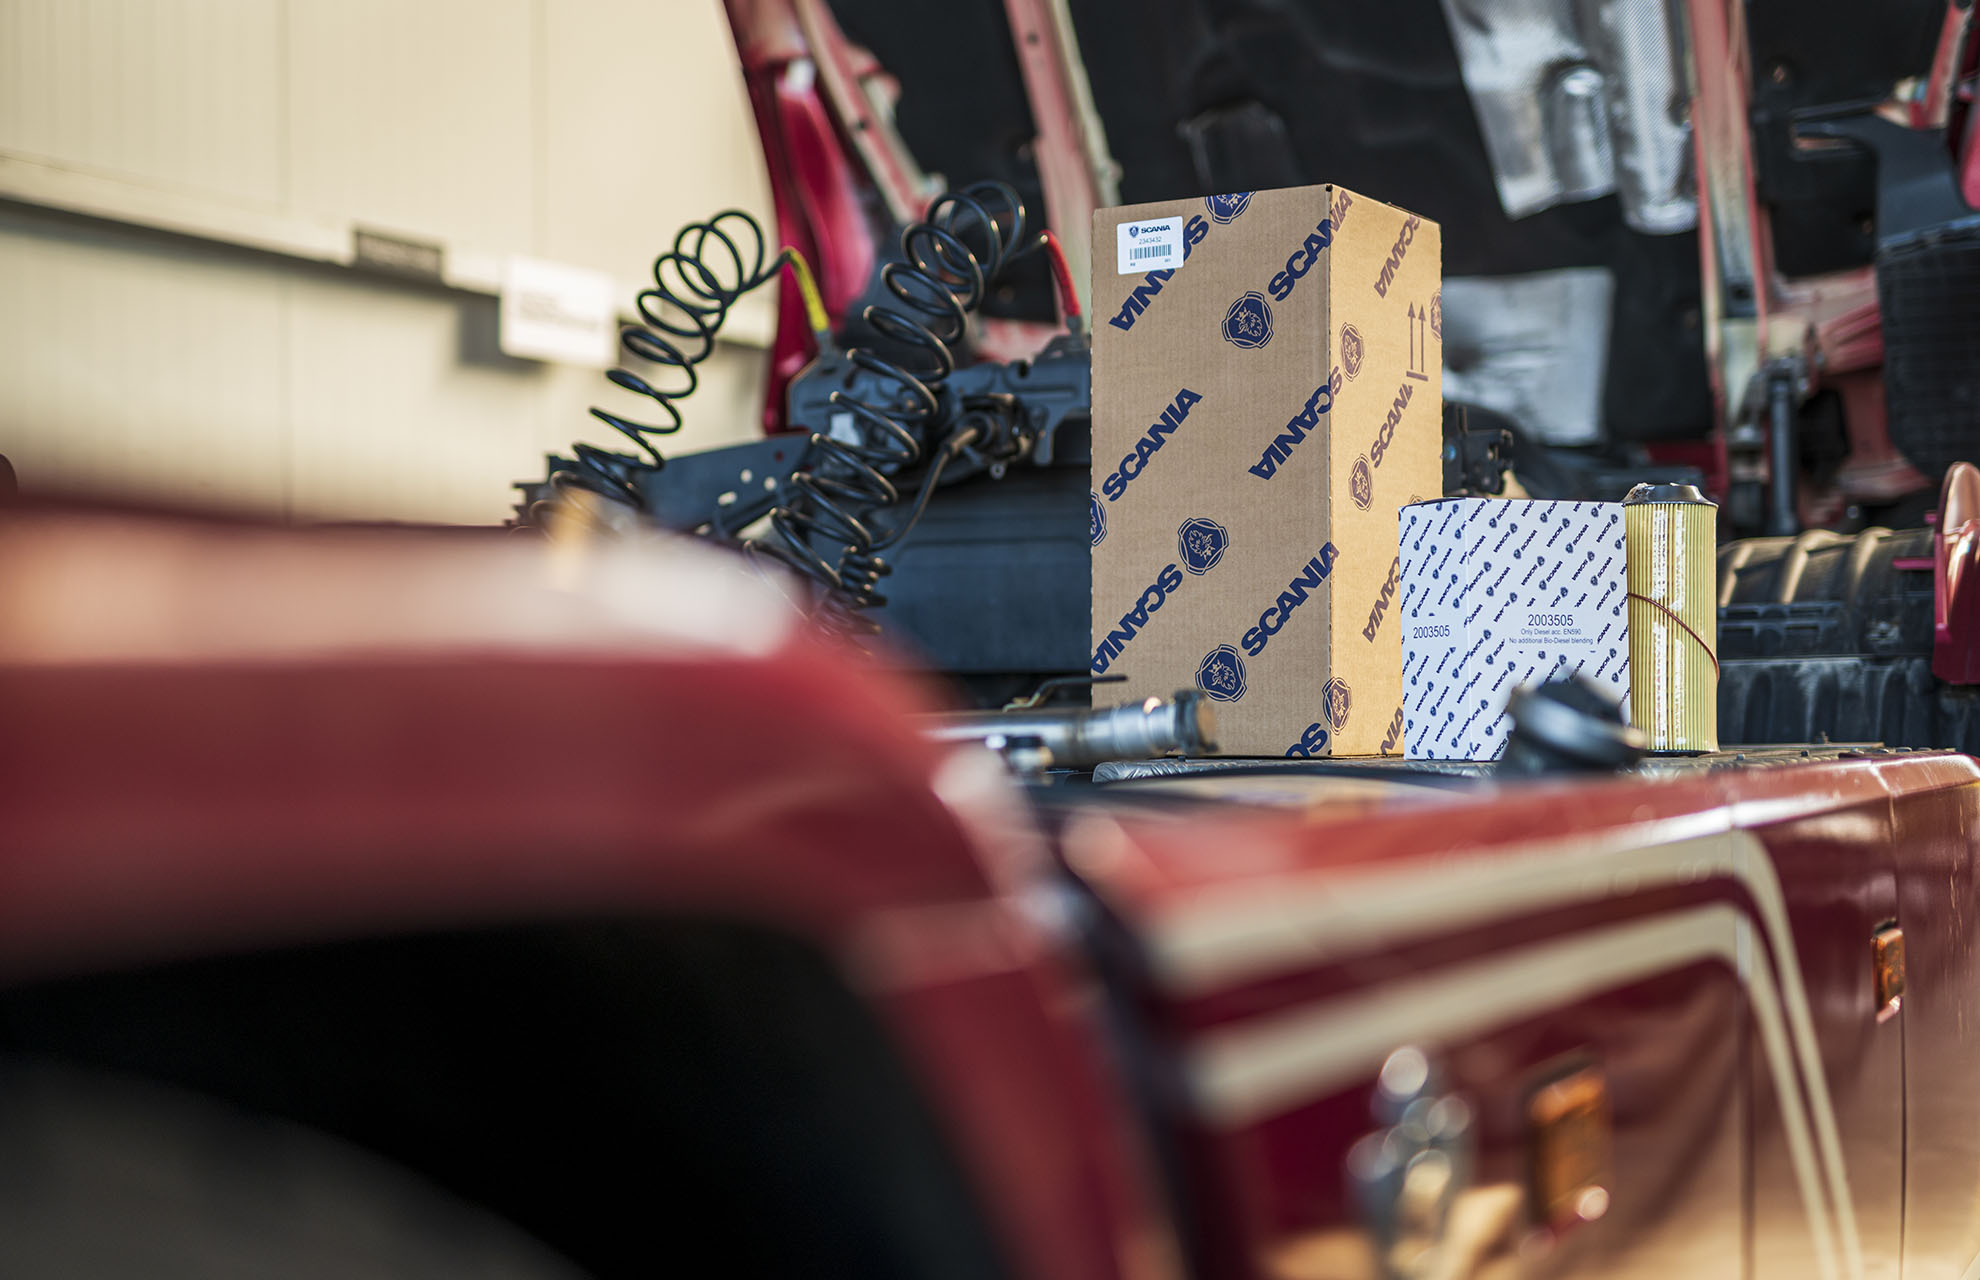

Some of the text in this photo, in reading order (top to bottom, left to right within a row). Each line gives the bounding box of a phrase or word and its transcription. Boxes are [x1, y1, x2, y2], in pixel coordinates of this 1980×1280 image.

[1141, 224, 1170, 233] SCANIA
[1268, 190, 1353, 301] SCANIA
[1102, 388, 1203, 502] SCANIA
[1248, 365, 1343, 480] SCANIA
[1371, 383, 1413, 468] SCANI
[1091, 563, 1184, 675] SCANIA
[1241, 541, 1340, 657] SCANIA
[1362, 556, 1400, 643] CANIA
[1413, 625, 1450, 639] 2003505
[1528, 614, 1574, 626] 2003505
[1571, 637, 1593, 645] blending
